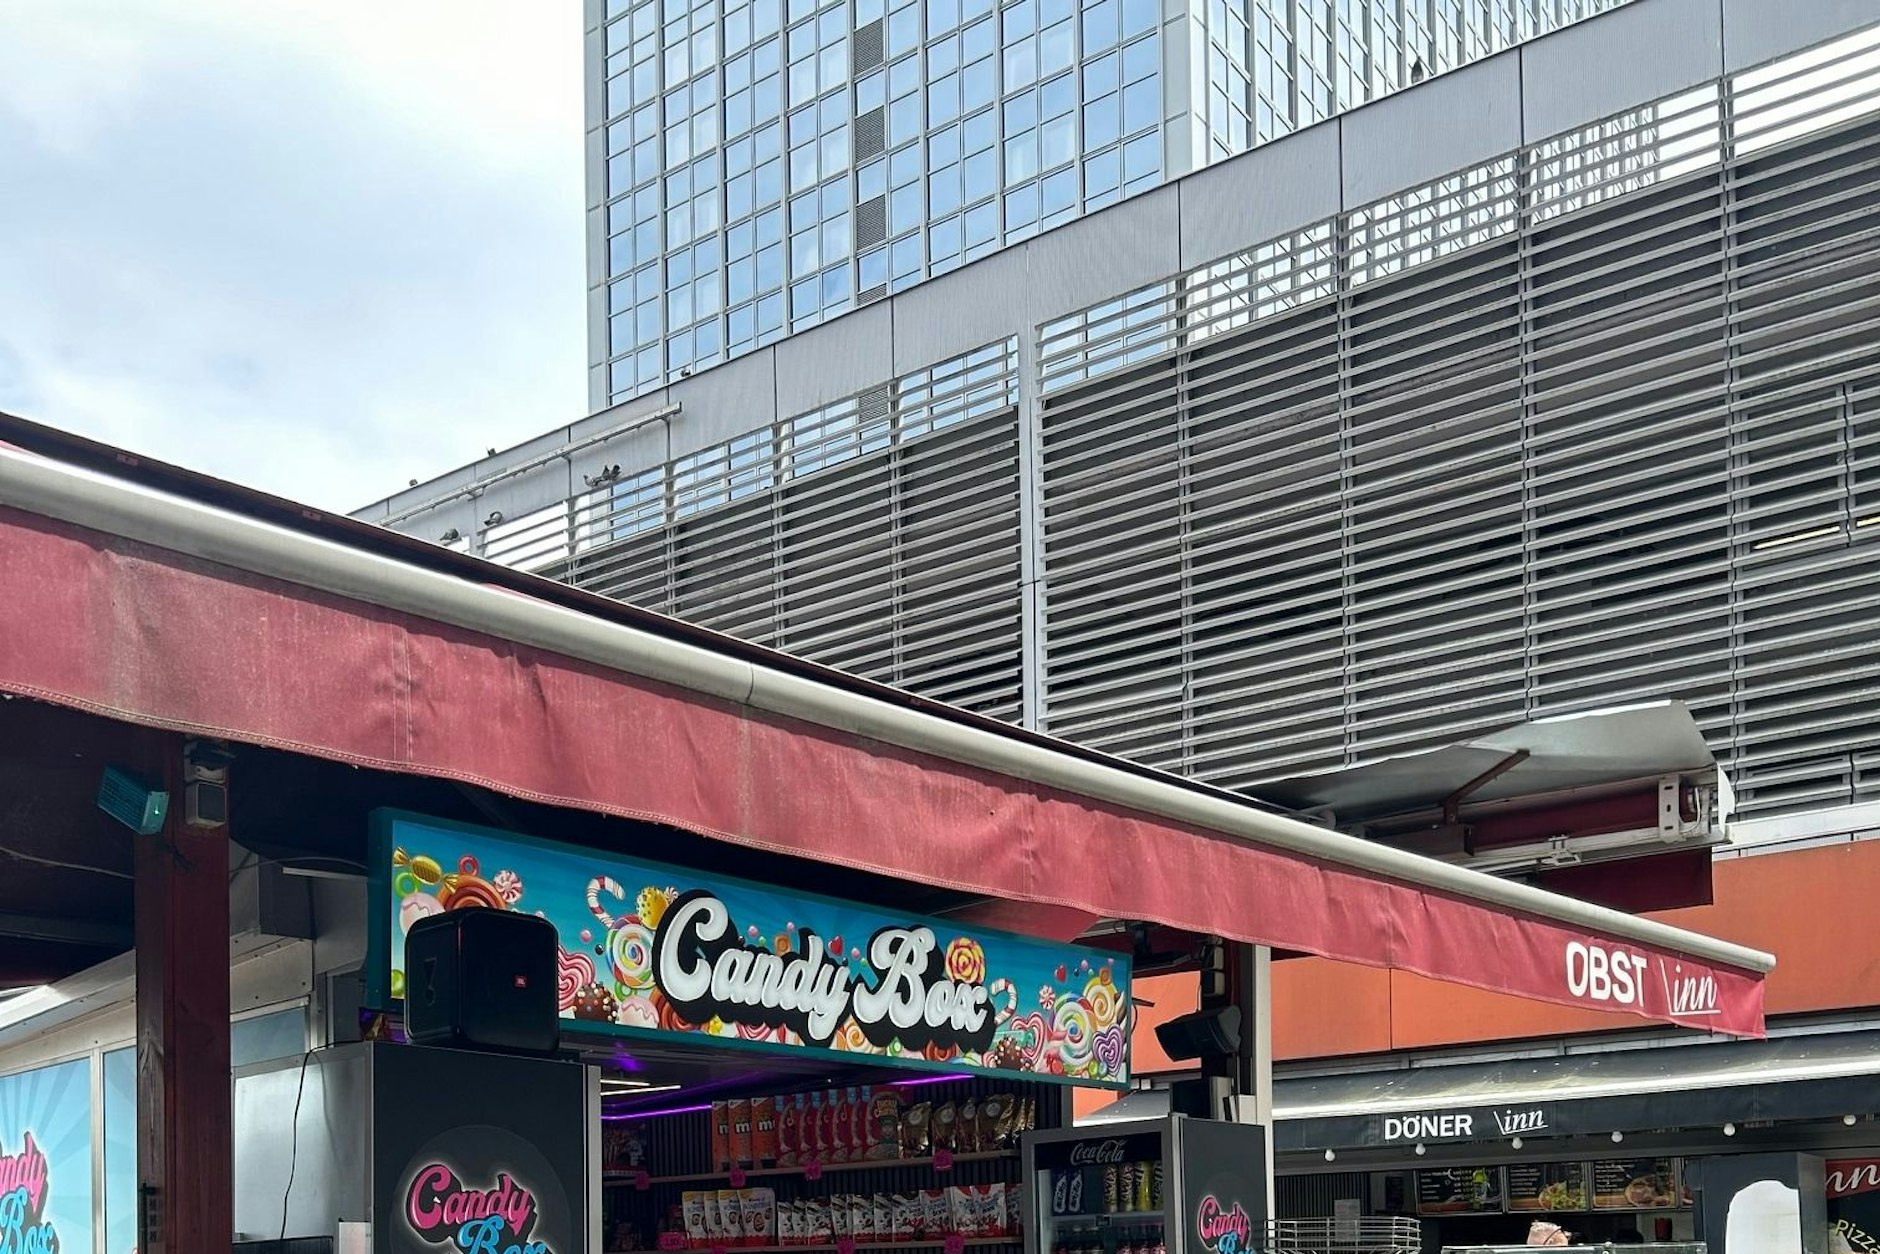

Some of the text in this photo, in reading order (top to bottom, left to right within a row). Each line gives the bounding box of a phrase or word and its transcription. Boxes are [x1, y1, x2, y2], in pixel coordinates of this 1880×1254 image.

[659, 897, 990, 1041] Candy Box
[1565, 940, 1648, 1008] OBST
[1384, 1114, 1473, 1140] DÖNER
[0, 1132, 47, 1214] ndy
[411, 1164, 531, 1237] Candy
[1200, 1197, 1249, 1246] Candy
